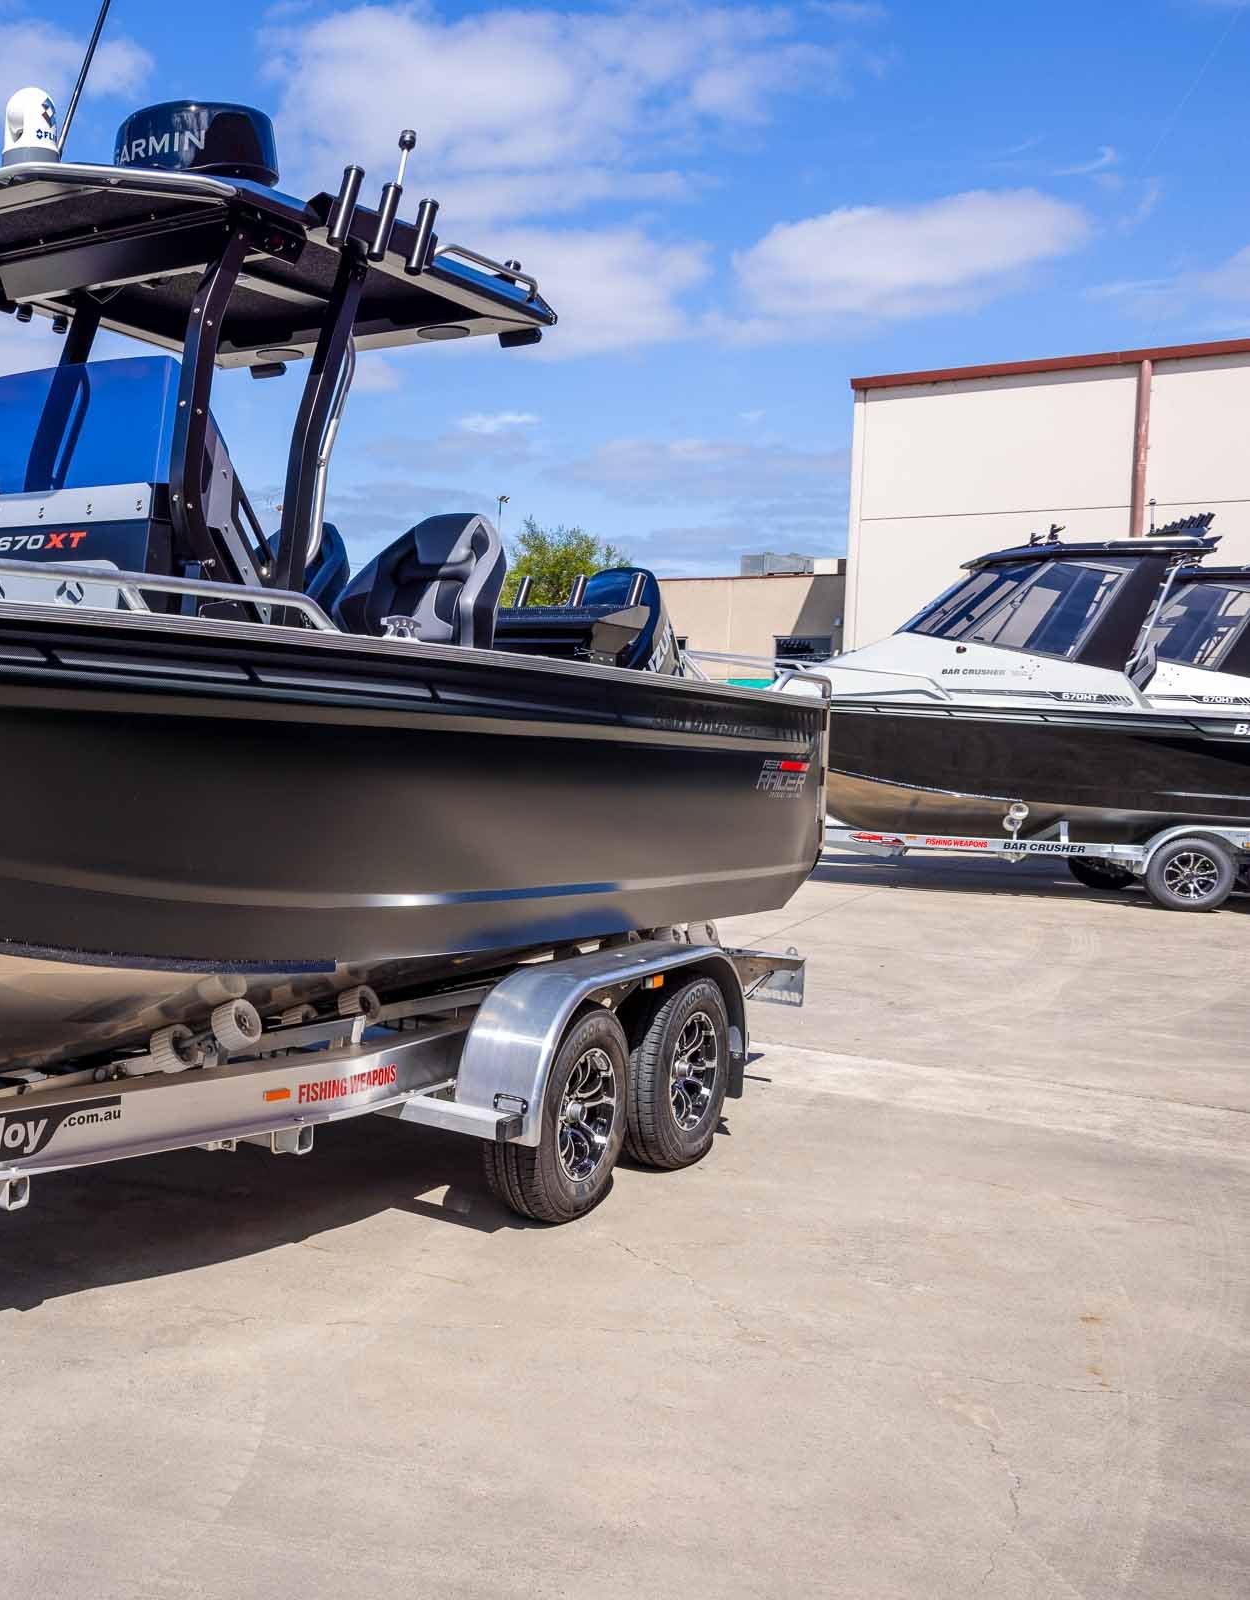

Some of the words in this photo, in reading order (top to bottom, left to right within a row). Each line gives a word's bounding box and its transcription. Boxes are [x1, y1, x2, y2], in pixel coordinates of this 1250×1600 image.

[1061, 693, 1099, 701] 670HT
[925, 838, 952, 846] FISHING
[953, 839, 988, 848] WEAPONS
[1003, 842, 1026, 851] BAR
[1030, 843, 1086, 853] CRUSHER
[298, 1078, 347, 1104] FISHING
[350, 1064, 397, 1094] WEAPONS
[63, 1109, 121, 1128] .com.au
